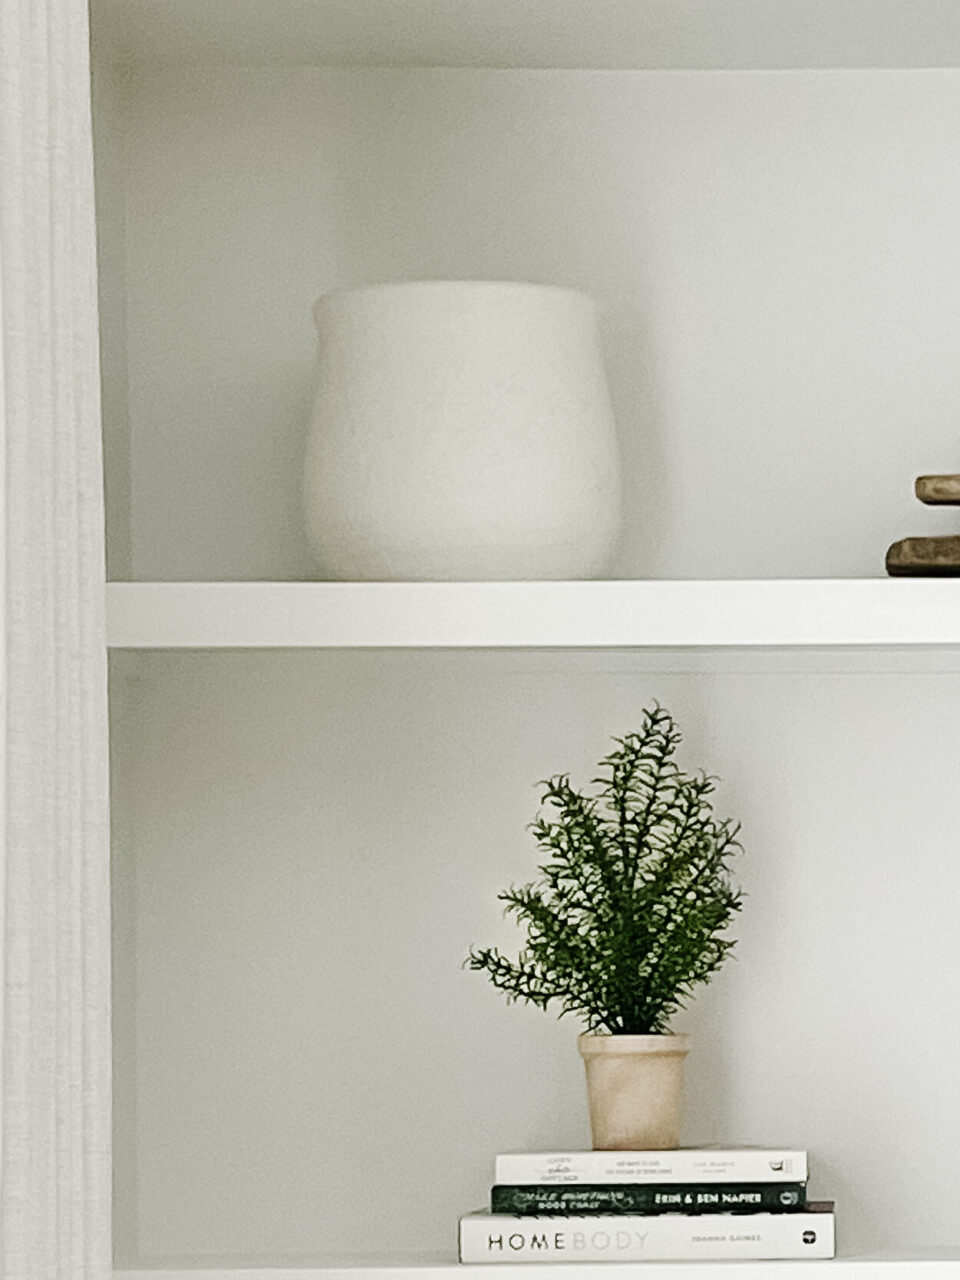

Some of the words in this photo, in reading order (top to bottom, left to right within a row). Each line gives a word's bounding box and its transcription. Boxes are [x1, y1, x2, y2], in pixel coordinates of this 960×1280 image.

[654, 1193, 682, 1204] ERIN
[697, 1193, 719, 1204] BEN
[721, 1192, 762, 1203] NAPIER
[488, 1229, 650, 1251] HOMEBODY
